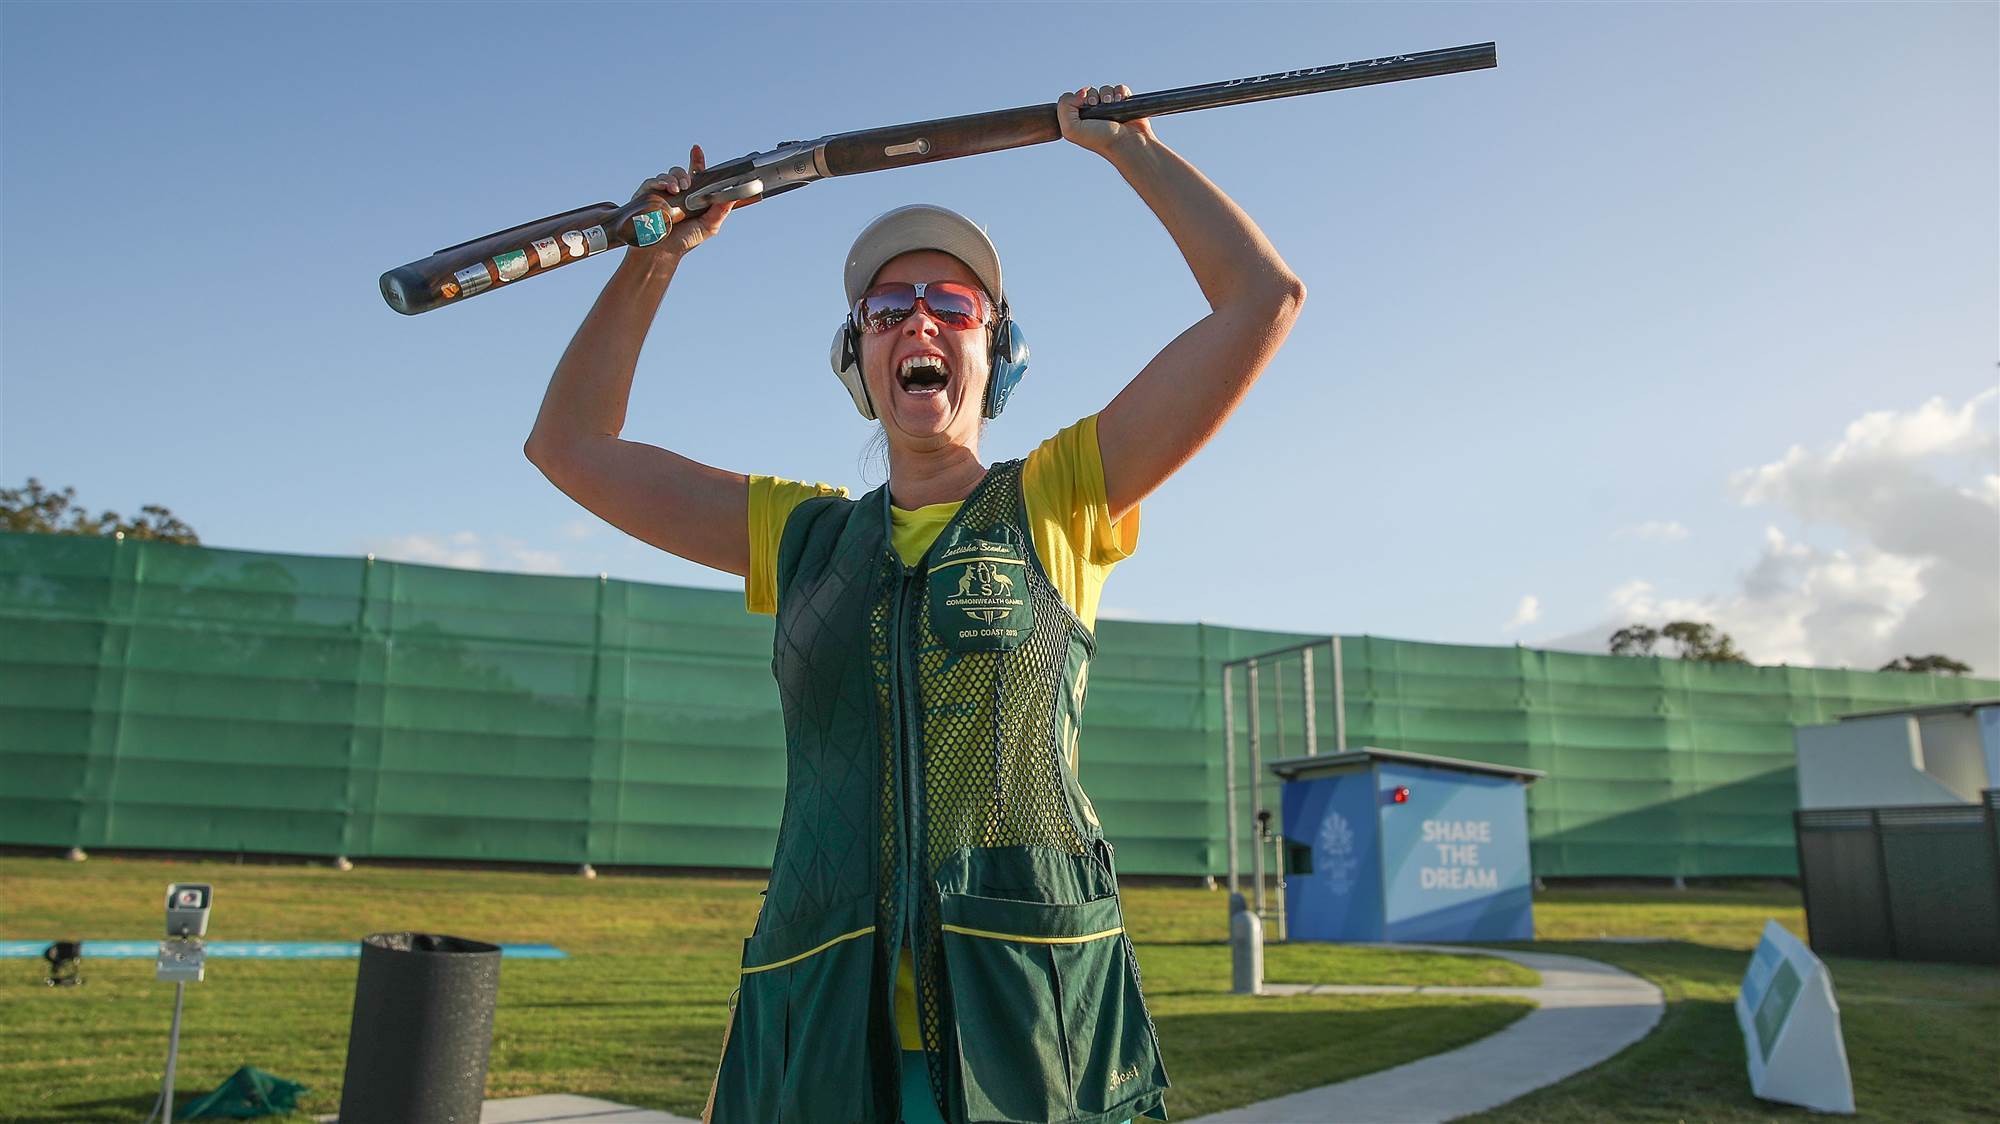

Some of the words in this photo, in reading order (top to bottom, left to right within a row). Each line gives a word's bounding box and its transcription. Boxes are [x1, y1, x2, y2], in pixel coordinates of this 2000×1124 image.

[946, 598, 1004, 606] COMMONWEALTH
[1004, 598, 1024, 606] GAMES
[959, 629, 978, 638] GOLD
[980, 628, 1004, 637] COAST
[1005, 628, 1018, 637] 2018
[1421, 820, 1491, 843] SHARE
[1437, 843, 1479, 866] THE
[1420, 867, 1498, 890] DREAM
